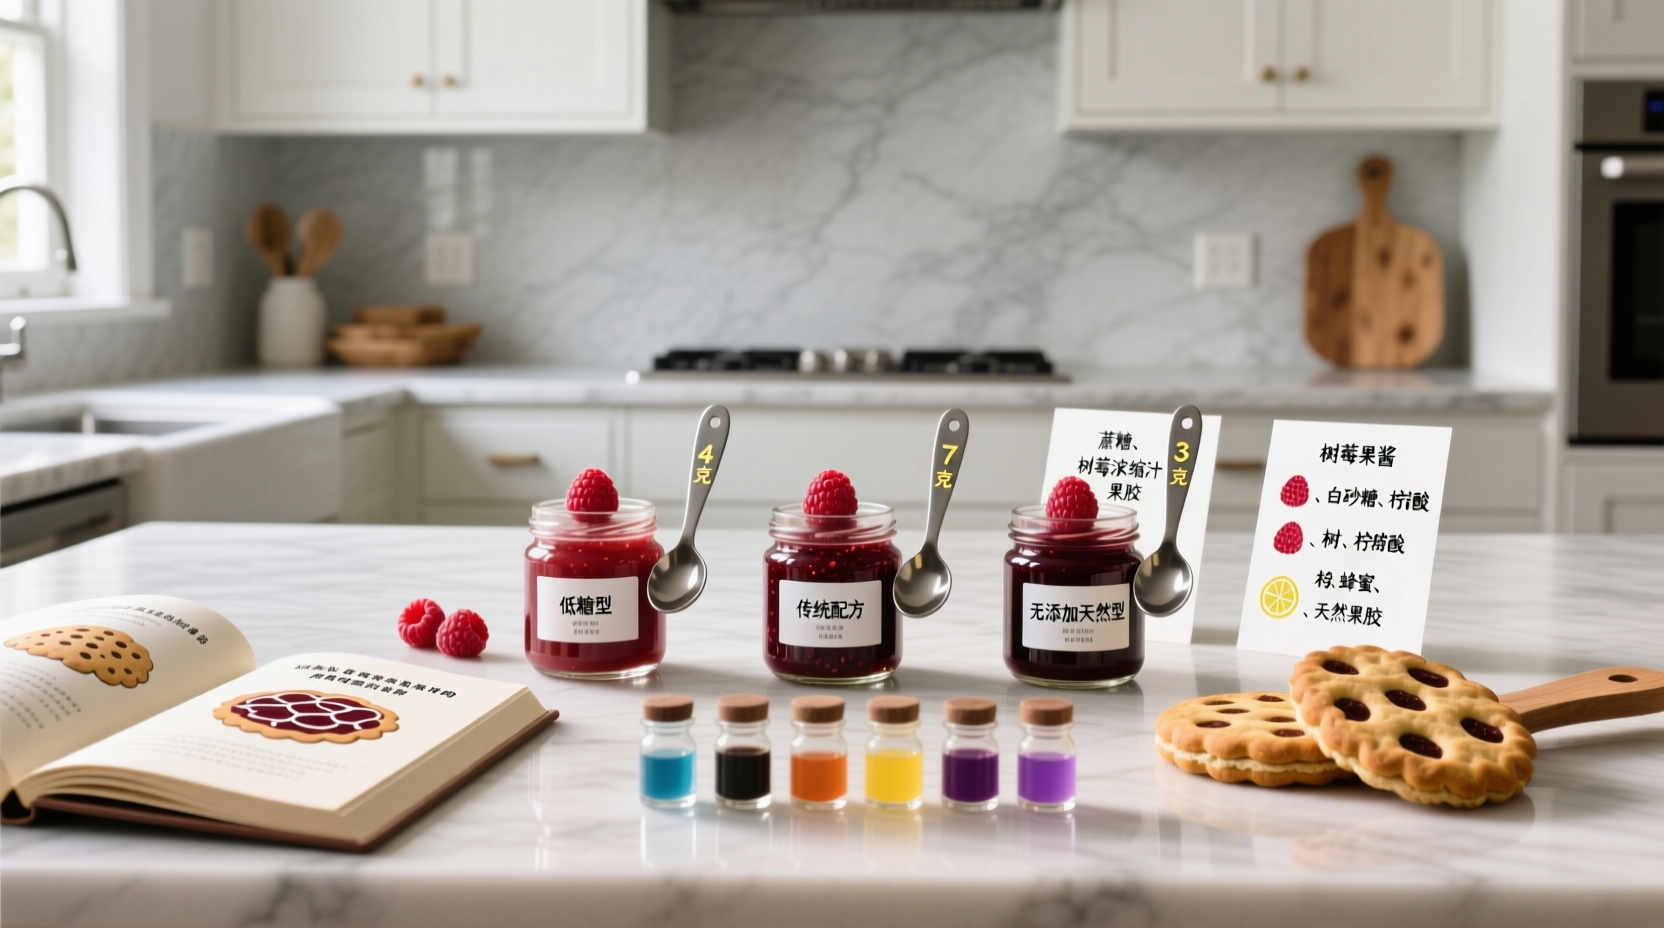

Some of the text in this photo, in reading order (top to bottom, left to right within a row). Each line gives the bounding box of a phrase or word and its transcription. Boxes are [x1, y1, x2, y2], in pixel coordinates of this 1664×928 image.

[692, 444, 714, 485] 4克
[934, 443, 959, 489] 7克
[1169, 441, 1190, 486] 3克
[1319, 443, 1397, 468] 树莓果酱
[1106, 482, 1143, 502] 果胶
[796, 598, 865, 620] 传统配方
[1030, 600, 1126, 623] 无添加天然型
